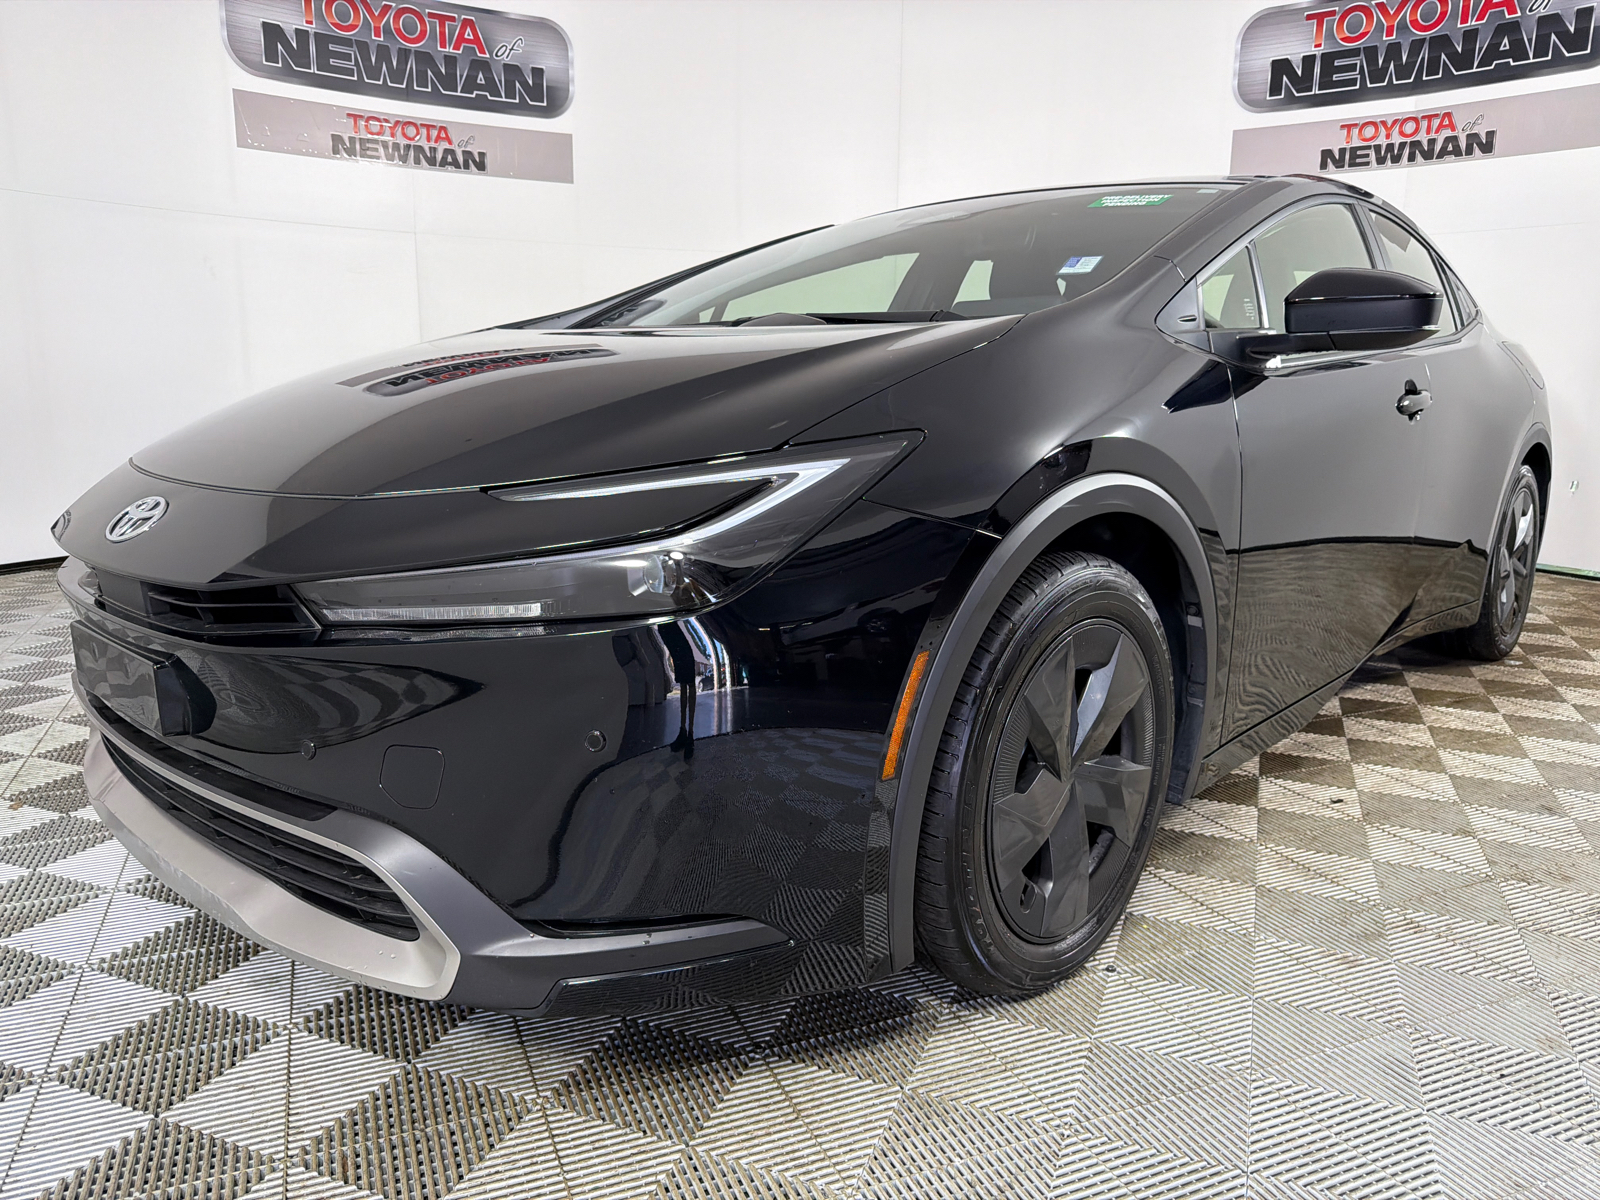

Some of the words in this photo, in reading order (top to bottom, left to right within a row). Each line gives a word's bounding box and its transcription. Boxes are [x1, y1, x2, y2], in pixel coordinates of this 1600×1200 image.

[260, 20, 547, 106] NEWNAN
[493, 36, 524, 60] of
[1267, 3, 1597, 100] NEWNAN
[346, 112, 454, 146] TOYOTA
[457, 135, 475, 149] of
[1340, 111, 1457, 144] TOYOTA
[1461, 113, 1484, 132] of
[330, 133, 487, 173] NEWNAN
[1319, 129, 1497, 172] NEWNAN
